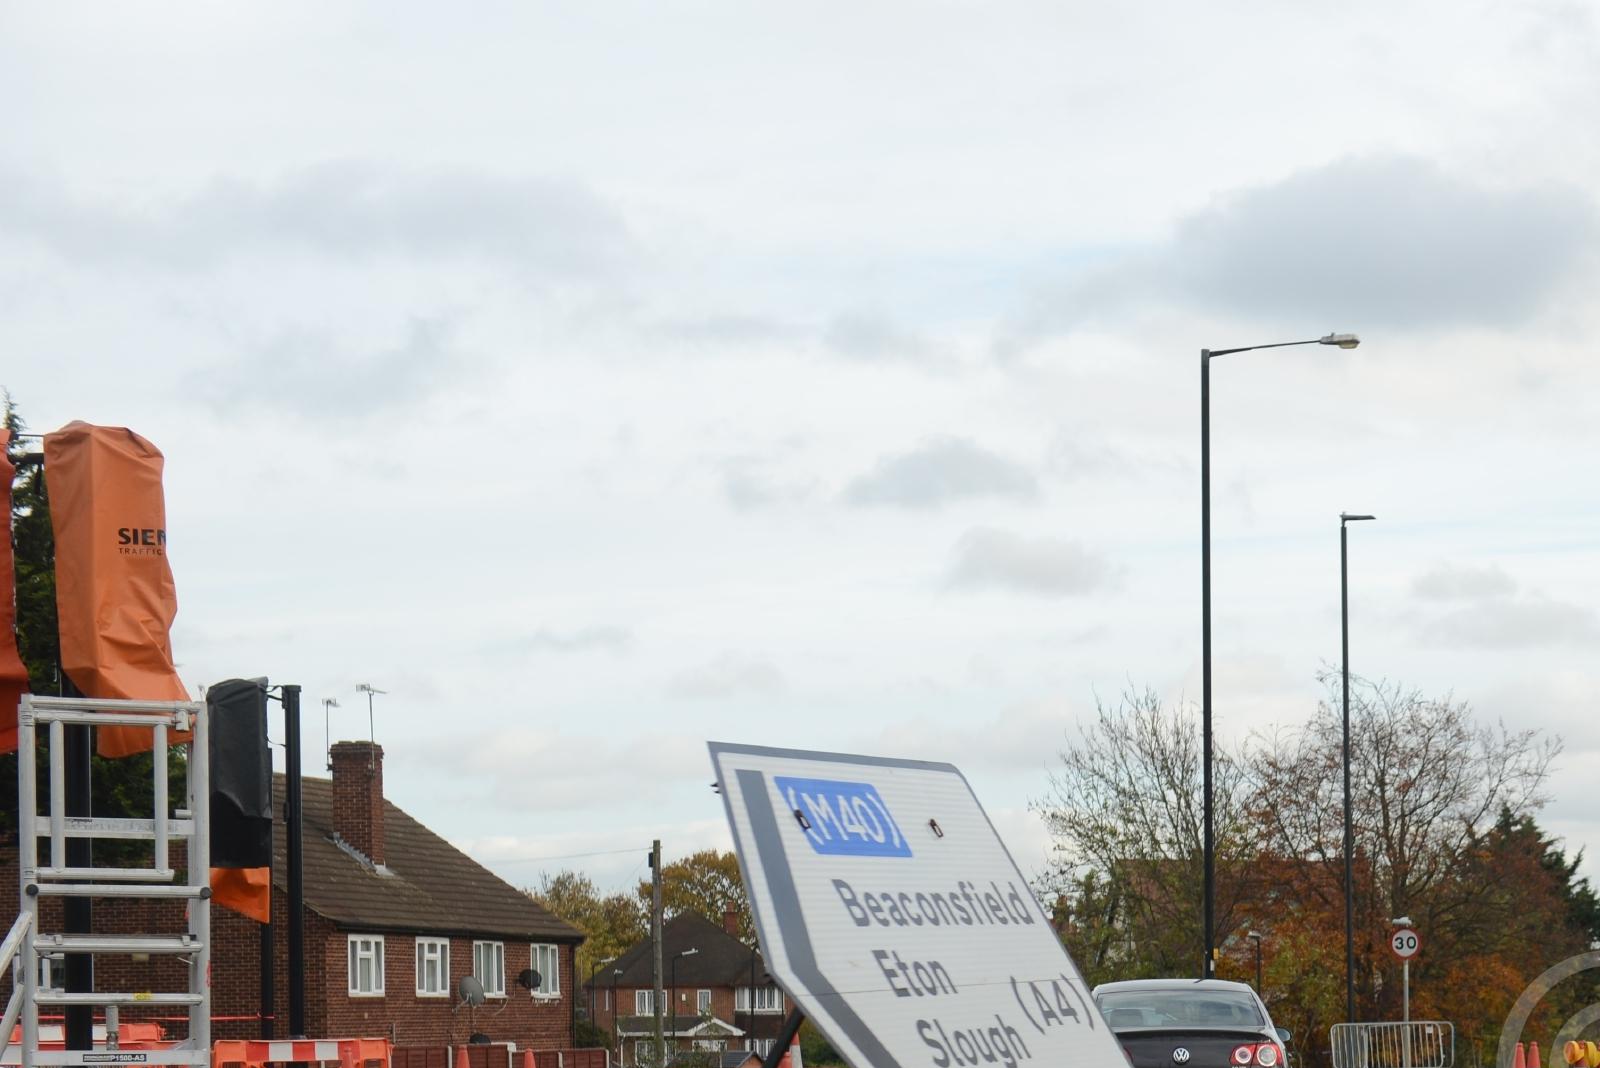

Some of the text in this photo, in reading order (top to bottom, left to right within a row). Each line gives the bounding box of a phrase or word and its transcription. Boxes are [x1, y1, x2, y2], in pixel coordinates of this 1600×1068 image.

[787, 785, 901, 849] (M40)
[831, 878, 1035, 927] Beaconsfield
[1394, 936, 1417, 950] 30
[871, 949, 959, 997] Eton
[1010, 972, 1095, 1035] (A4)
